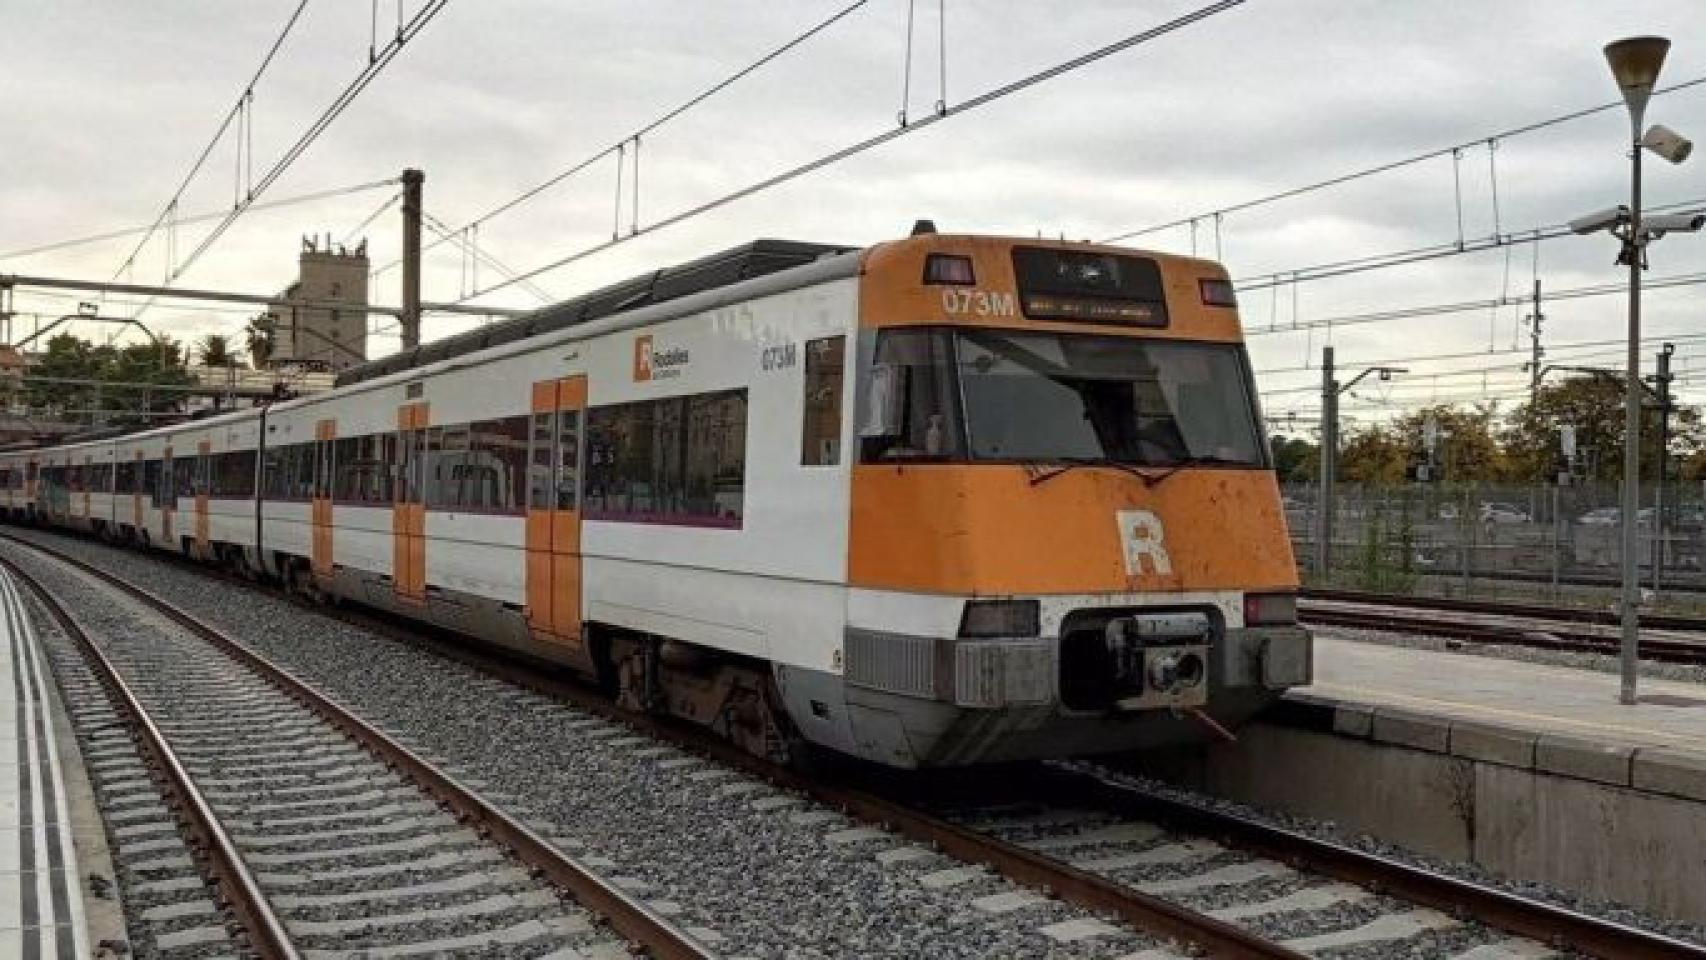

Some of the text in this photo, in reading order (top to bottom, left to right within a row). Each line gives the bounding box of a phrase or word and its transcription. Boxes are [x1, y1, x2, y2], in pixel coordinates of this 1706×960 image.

[942, 288, 1015, 316] 073M
[639, 343, 651, 371] R
[653, 347, 689, 368] Rodalies
[762, 343, 796, 371] 073M
[1115, 509, 1172, 576] R
